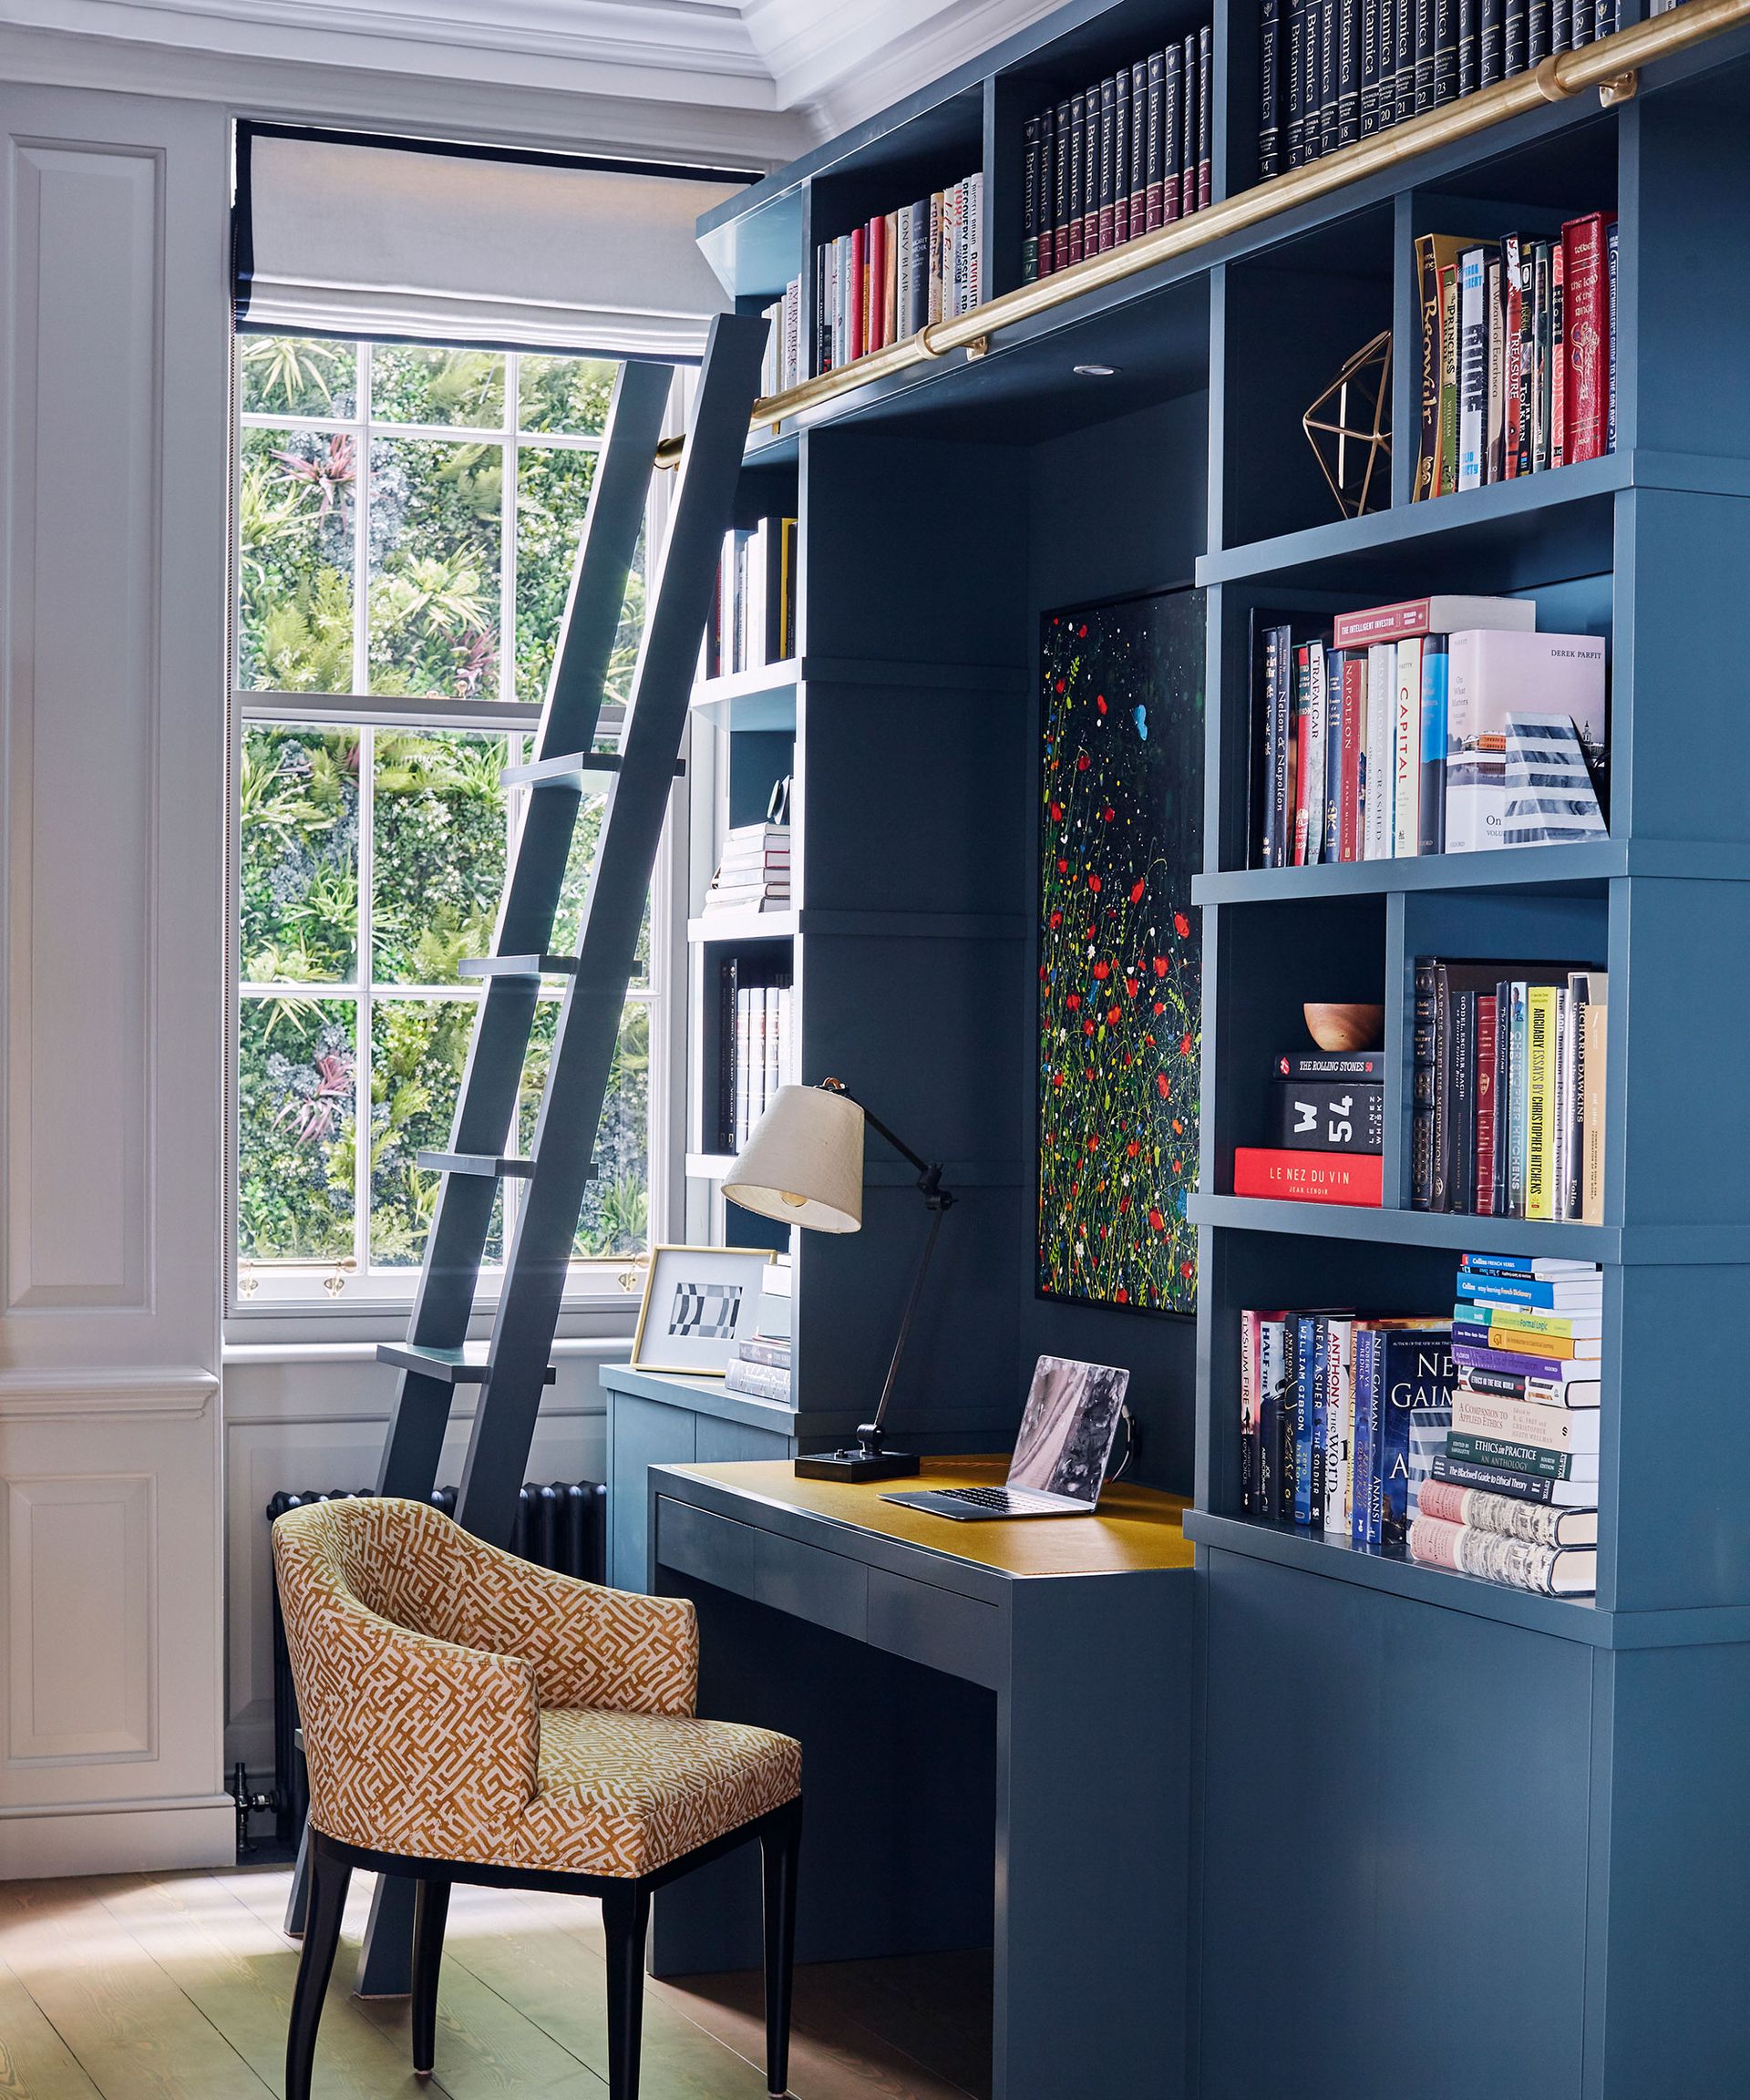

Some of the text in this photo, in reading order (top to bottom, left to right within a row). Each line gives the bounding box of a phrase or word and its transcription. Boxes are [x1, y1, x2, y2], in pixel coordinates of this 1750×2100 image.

[1290, 24, 1300, 112] Britannica
[1306, 13, 1317, 103] Britannica
[1323, 3, 1333, 94] Britannica
[1263, 32, 1273, 120] Britannica
[1437, 82, 1446, 95] 23
[1381, 109, 1391, 121] 20
[1397, 101, 1405, 113] 21
[1417, 92, 1426, 104] 22
[1132, 100, 1142, 182] Britannica
[1149, 91, 1158, 174] Britannica
[1167, 83, 1176, 166] Britannica
[1322, 136, 1329, 148] 17
[1341, 126, 1349, 138] 18
[1364, 118, 1373, 130] 19
[1086, 124, 1096, 204] Britannica
[1102, 117, 1110, 197] Britannica
[1116, 108, 1125, 190] Britannica
[1289, 153, 1296, 164] 15
[1305, 145, 1312, 157] 16
[1025, 152, 1034, 229] Britannica
[1040, 146, 1048, 222] Britannica
[1057, 139, 1065, 217] Britannica
[1071, 131, 1080, 211] Britannica
[901, 211, 910, 251] TONY
[1446, 304, 1457, 376] PRINCESS
[1493, 276, 1502, 398] A Wizard of Earthsea
[1508, 329, 1521, 400] TREASURE
[1341, 625, 1349, 635] THE
[1349, 620, 1374, 634] INTELLIGENT
[1374, 616, 1395, 629] INVESTOR
[1550, 649, 1601, 660] DEREK PARFIT
[1312, 655, 1321, 739] TRAFALGAR
[1344, 664, 1354, 749] NAPOLEON
[1276, 691, 1287, 811] Nelson & Napoléon
[1399, 686, 1409, 784] CAPITAL
[1486, 815, 1502, 826] On
[1533, 1007, 1546, 1048] ARGUABLY
[1300, 1060, 1374, 1073] THE ROLLING STONES 50
[1532, 1048, 1546, 1080] ESSAYS
[1576, 1002, 1587, 1124] RICHARD DAWKINS
[1511, 1030, 1522, 1190] CHRISTOPHER HITCHENS
[1532, 1084, 1544, 1096] BY
[1531, 1096, 1544, 1153] CHRISTOPHER
[1270, 1168, 1349, 1184] LE NEZ DU VIN
[1529, 1154, 1543, 1194] HITCHENS
[1472, 1257, 1488, 1266] Collins
[1462, 1282, 1476, 1291] Collins
[1316, 1323, 1324, 1358] NEAL
[1519, 1318, 1549, 1332] Formal Logic
[1262, 1327, 1271, 1368] HALF
[1299, 1325, 1307, 1380] WILLIAM
[1417, 1353, 1454, 1377] NE
[1314, 1364, 1323, 1408] ASHER
[1331, 1333, 1341, 1409] ANTHONY
[1371, 1337, 1382, 1432] NEIL GAIMAN
[1471, 1375, 1483, 1385] ETHICS
[1483, 1377, 1488, 1385] IN
[1502, 1381, 1514, 1390] WORLD
[1458, 1403, 1508, 1421] A COMPANION TO
[1458, 1413, 1504, 1430] APPLIED ETHICS
[1512, 1423, 1547, 1435] CHRISTOPHER
[1475, 1439, 1538, 1461] ETHICS in PRACTICE
[1481, 1455, 1529, 1471] AN ANTHOLOGY
[1312, 1453, 1321, 1495] SOLDIER
[1449, 1466, 1458, 1477] The
[1457, 1467, 1478, 1480] Blackwell
[1477, 1469, 1491, 1484] Guide
[1491, 1474, 1497, 1484] to
[1496, 1473, 1511, 1488] Ethical
[1511, 1476, 1529, 1492] Theory
[1372, 1476, 1382, 1523] ANANSI
